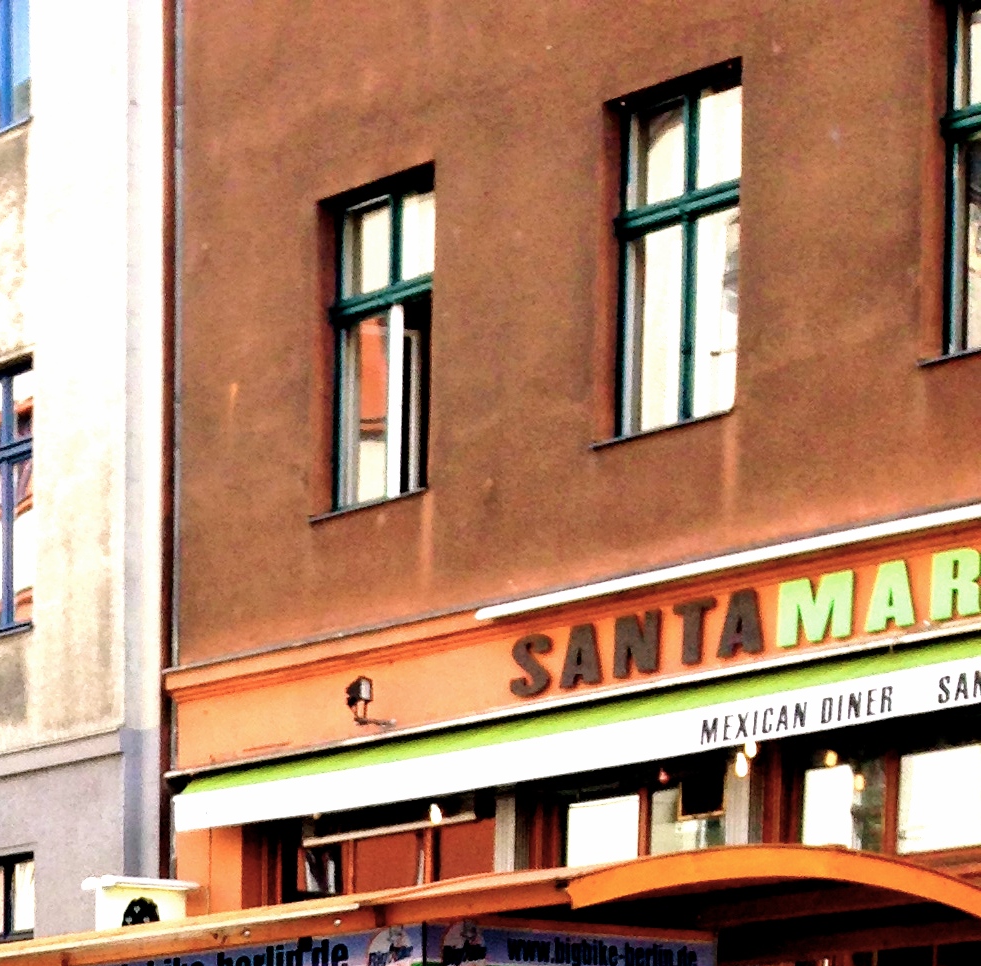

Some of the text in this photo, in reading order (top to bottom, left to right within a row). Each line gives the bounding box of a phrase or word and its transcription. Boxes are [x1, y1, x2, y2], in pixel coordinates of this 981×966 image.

[509, 587, 763, 699] SANTA
[700, 702, 808, 745] MEXICAN
[820, 686, 894, 724] DINER
